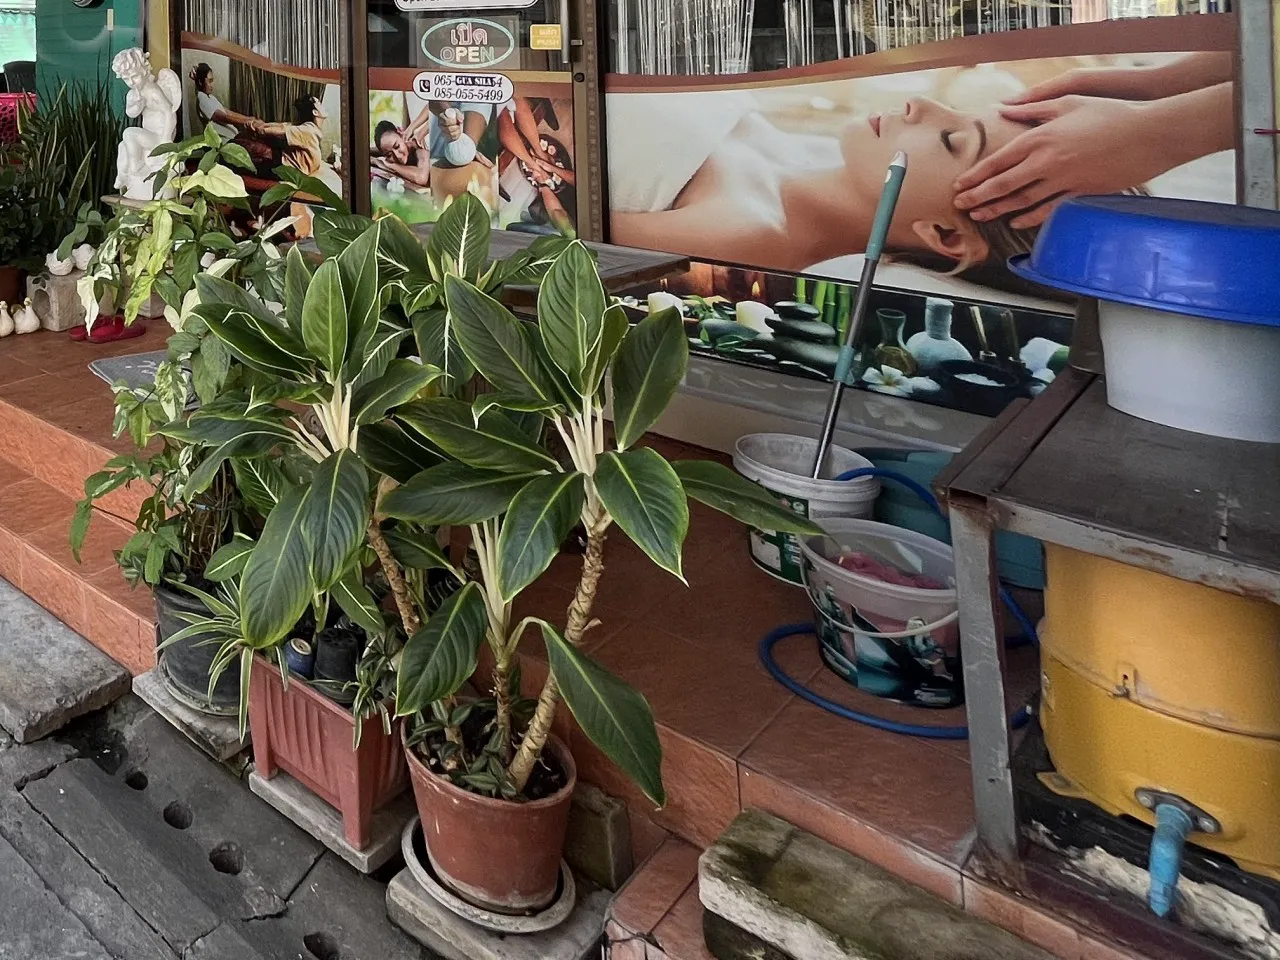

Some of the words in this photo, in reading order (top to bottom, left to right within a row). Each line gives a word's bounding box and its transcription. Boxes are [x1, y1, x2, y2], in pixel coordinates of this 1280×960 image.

[450, 22, 488, 46] เปิด
[440, 46, 495, 63] OPEN
[434, 87, 503, 101] 085-055-5499
